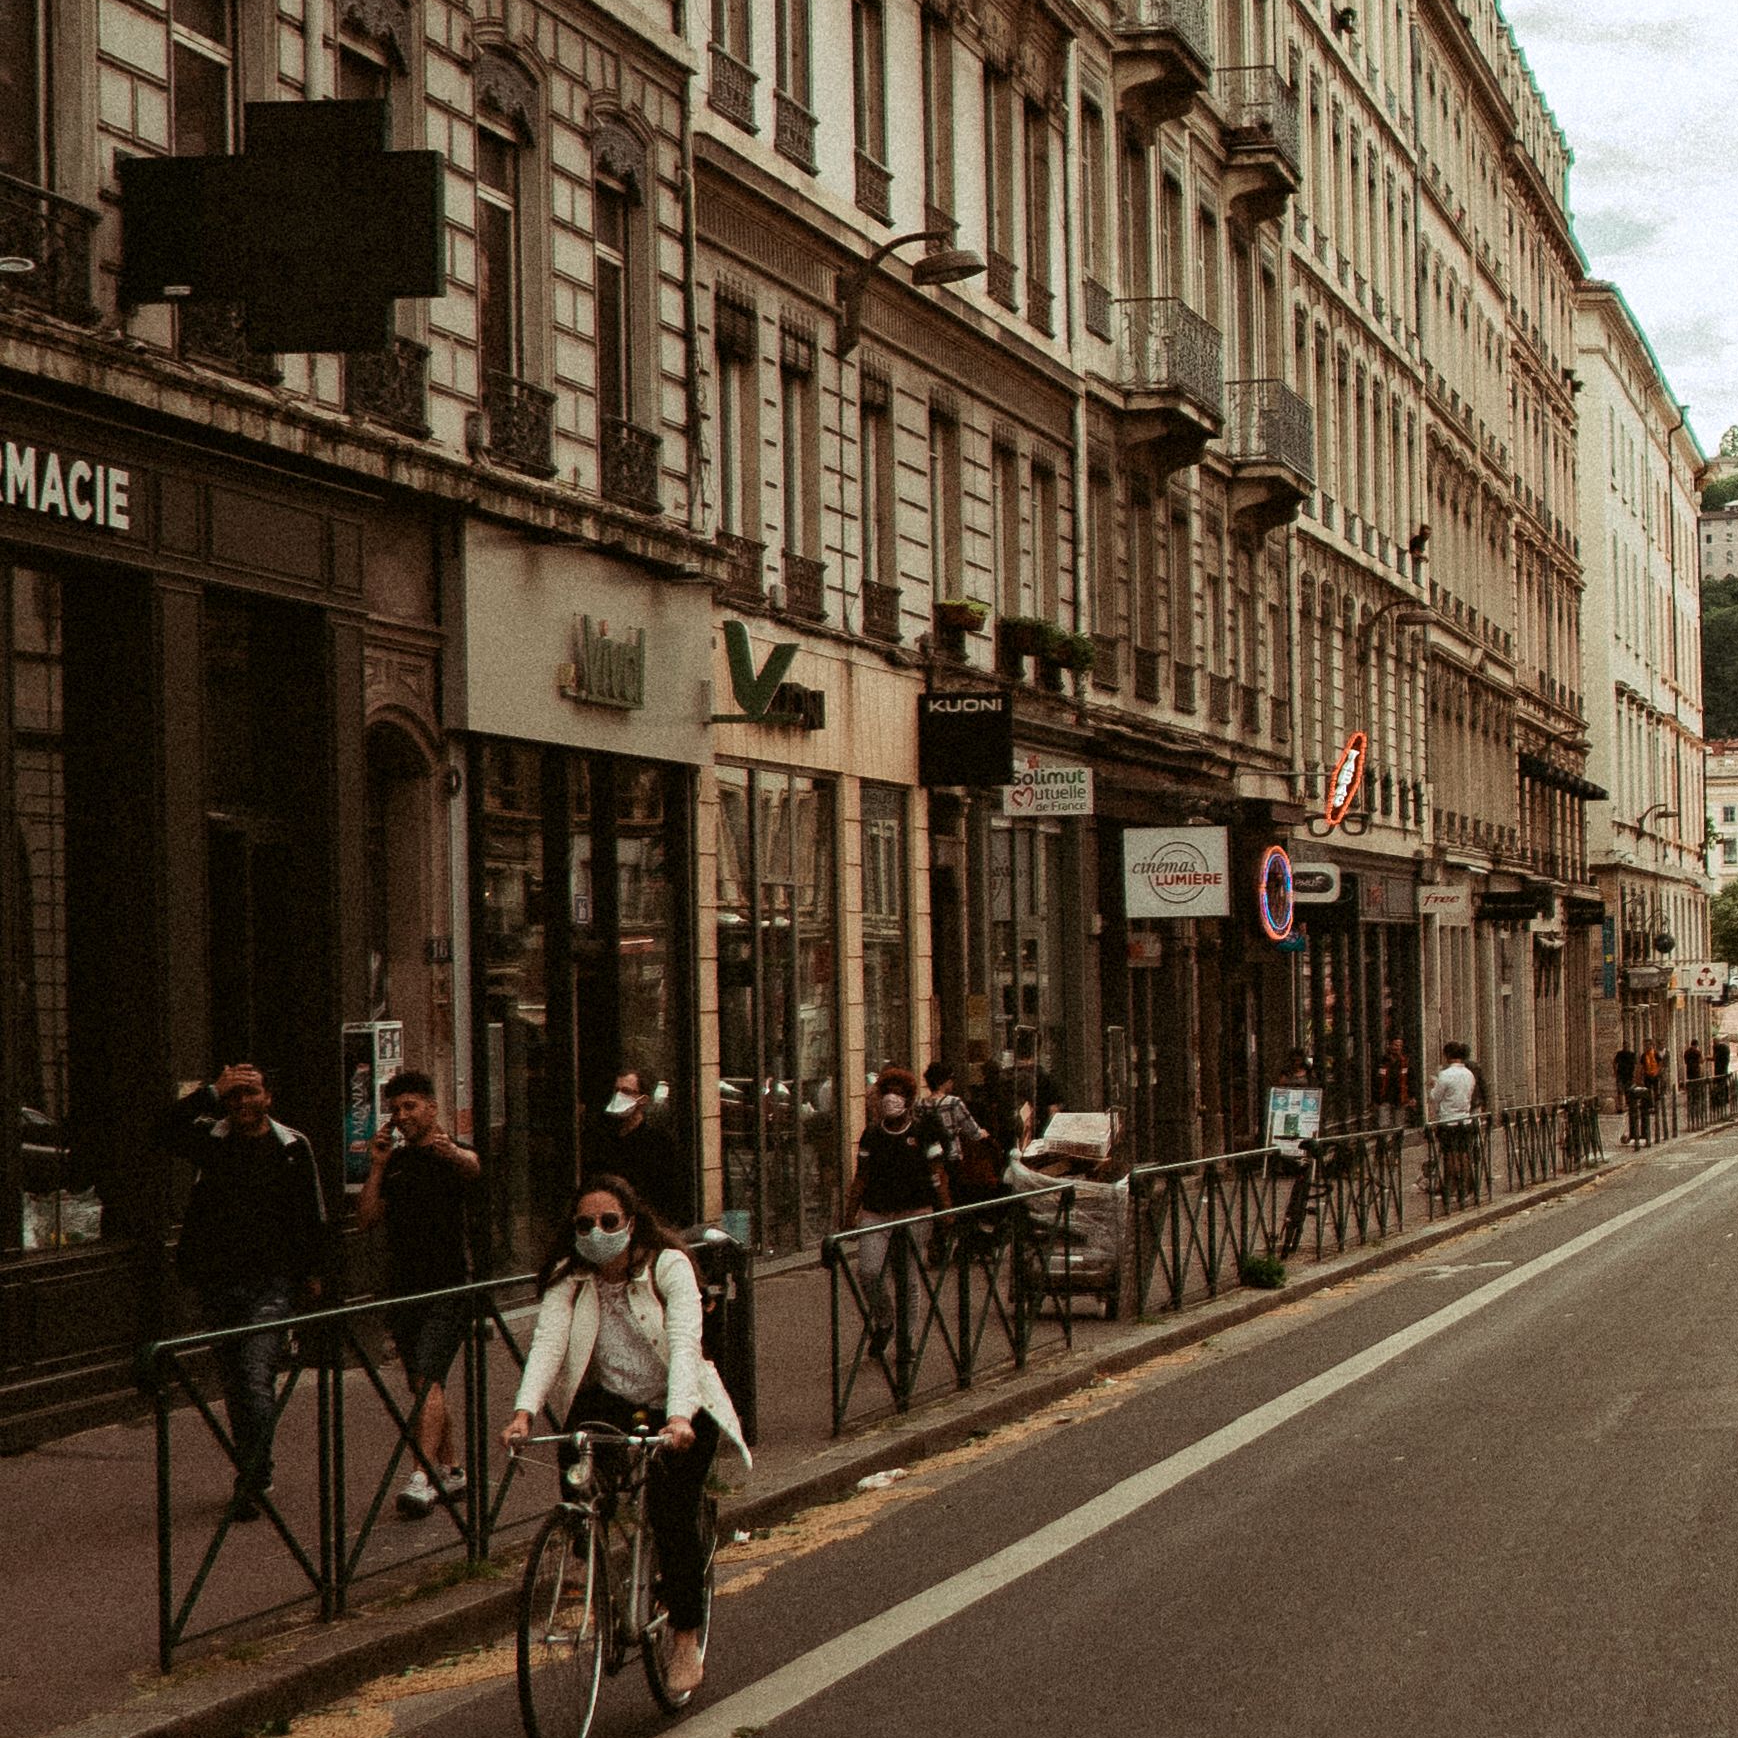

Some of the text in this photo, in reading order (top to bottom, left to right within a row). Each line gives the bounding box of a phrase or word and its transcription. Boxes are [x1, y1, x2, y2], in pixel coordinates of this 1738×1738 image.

[0, 441, 130, 530] MACIE
[928, 698, 1003, 713] KUONI
[1012, 768, 1086, 786] Solimut
[1036, 801, 1086, 812] de France
[1132, 857, 1196, 875] cinémas
[1155, 870, 1224, 887] LUMIÈRE
[1423, 892, 1460, 906] free
[351, 1081, 366, 1135] MANIX
